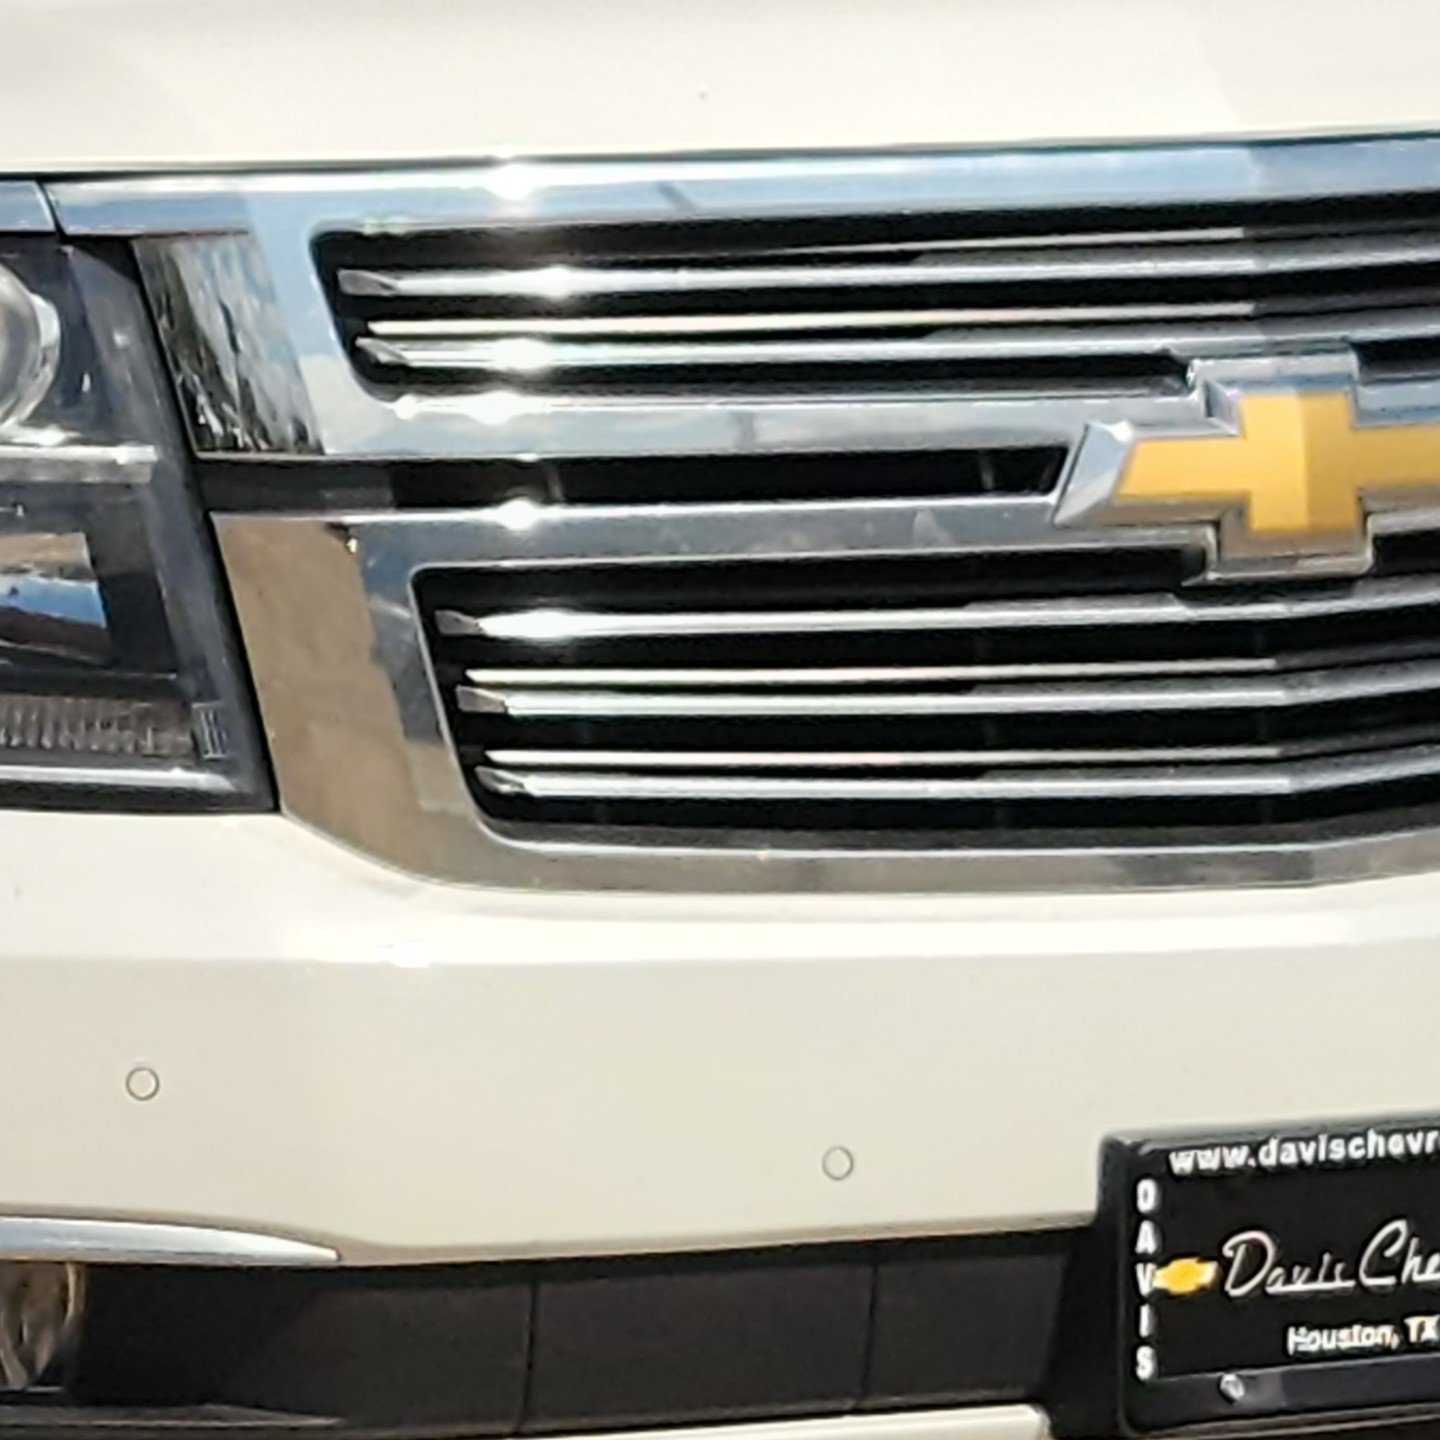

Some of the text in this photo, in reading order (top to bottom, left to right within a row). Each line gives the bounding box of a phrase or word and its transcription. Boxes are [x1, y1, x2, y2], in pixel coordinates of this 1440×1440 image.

[1134, 1177, 1160, 1382] DAVIS
[1221, 1228, 1357, 1299] Davis
[1286, 1322, 1401, 1356] Houston,
